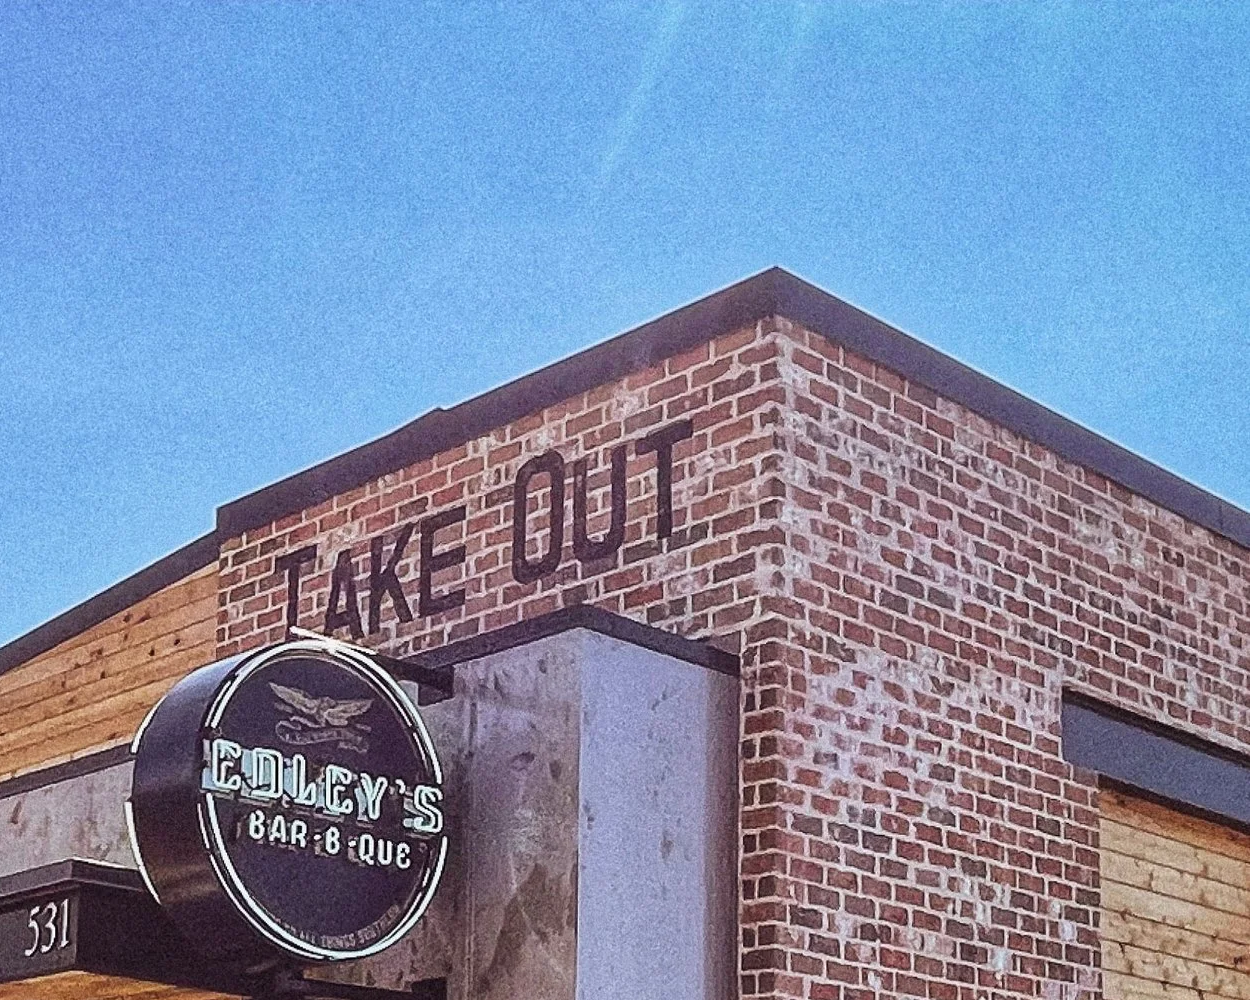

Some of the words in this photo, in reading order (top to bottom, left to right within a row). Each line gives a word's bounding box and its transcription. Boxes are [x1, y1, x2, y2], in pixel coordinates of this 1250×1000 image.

[274, 505, 466, 641] TAKE
[512, 419, 694, 585] OUT
[203, 738, 444, 834] EDLEY'S
[24, 898, 70, 957] 531
